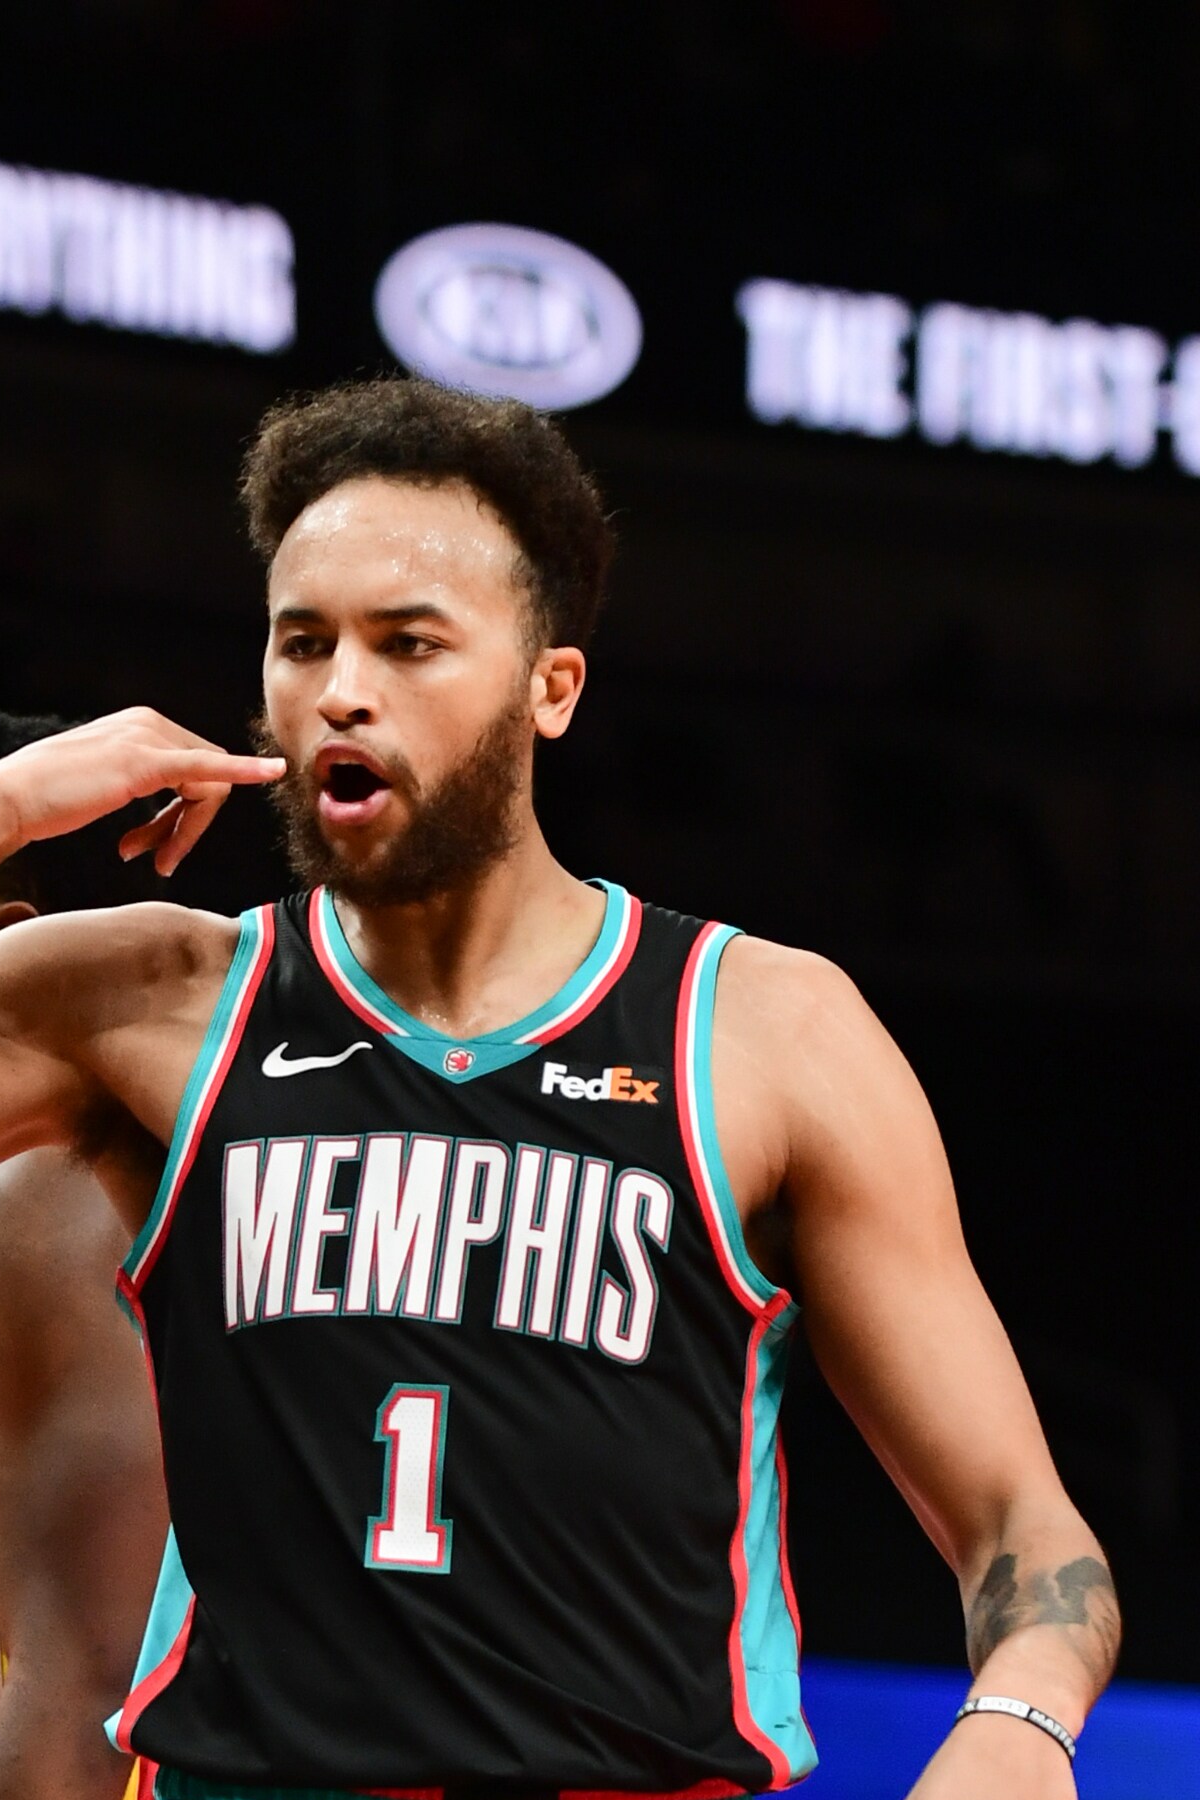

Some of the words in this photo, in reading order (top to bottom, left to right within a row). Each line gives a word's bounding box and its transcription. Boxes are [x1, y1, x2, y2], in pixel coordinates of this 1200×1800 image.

[743, 283, 907, 433] THE
[541, 1061, 660, 1104] FedEx
[221, 1132, 674, 1366] MEMPHIS
[364, 1383, 451, 1573] 1
